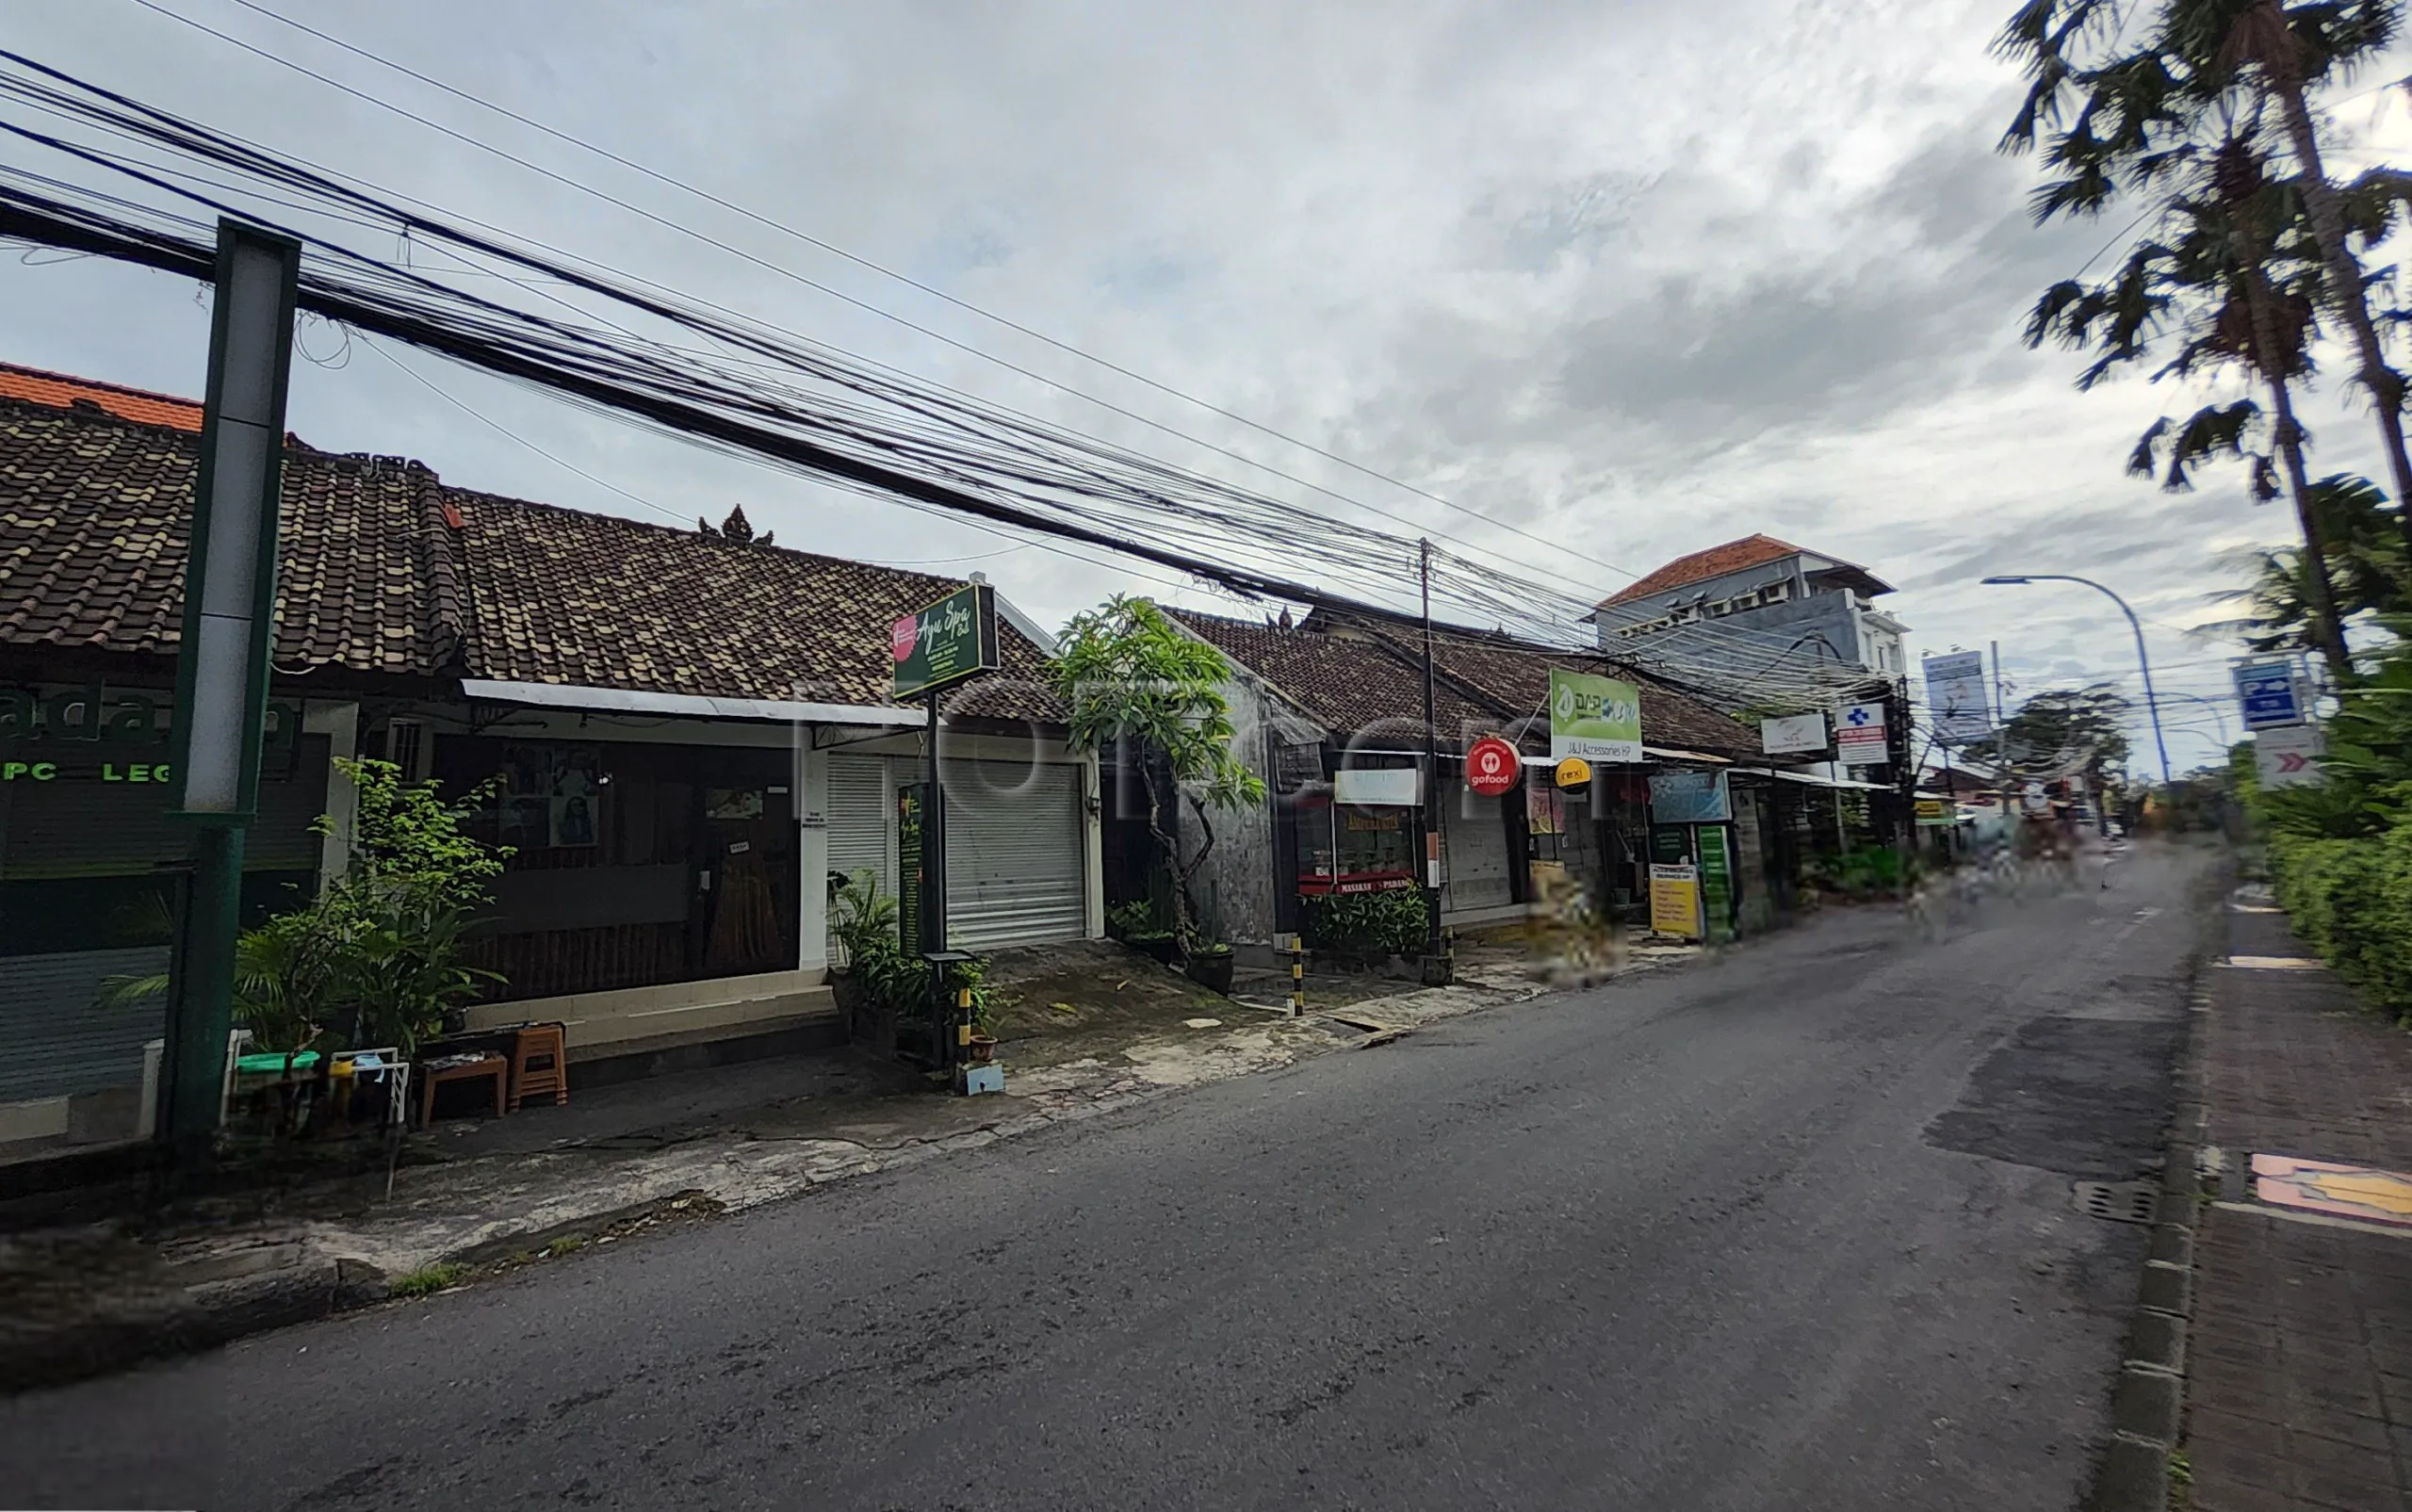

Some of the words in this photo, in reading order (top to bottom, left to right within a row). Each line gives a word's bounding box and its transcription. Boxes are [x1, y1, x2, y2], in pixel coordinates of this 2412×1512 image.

[916, 611, 943, 656] Ayu
[944, 600, 970, 641] Spa
[1568, 741, 1582, 755] J&J
[1582, 743, 1622, 756] Accessories
[1622, 745, 1631, 757] HP
[1472, 773, 1509, 787] gofood
